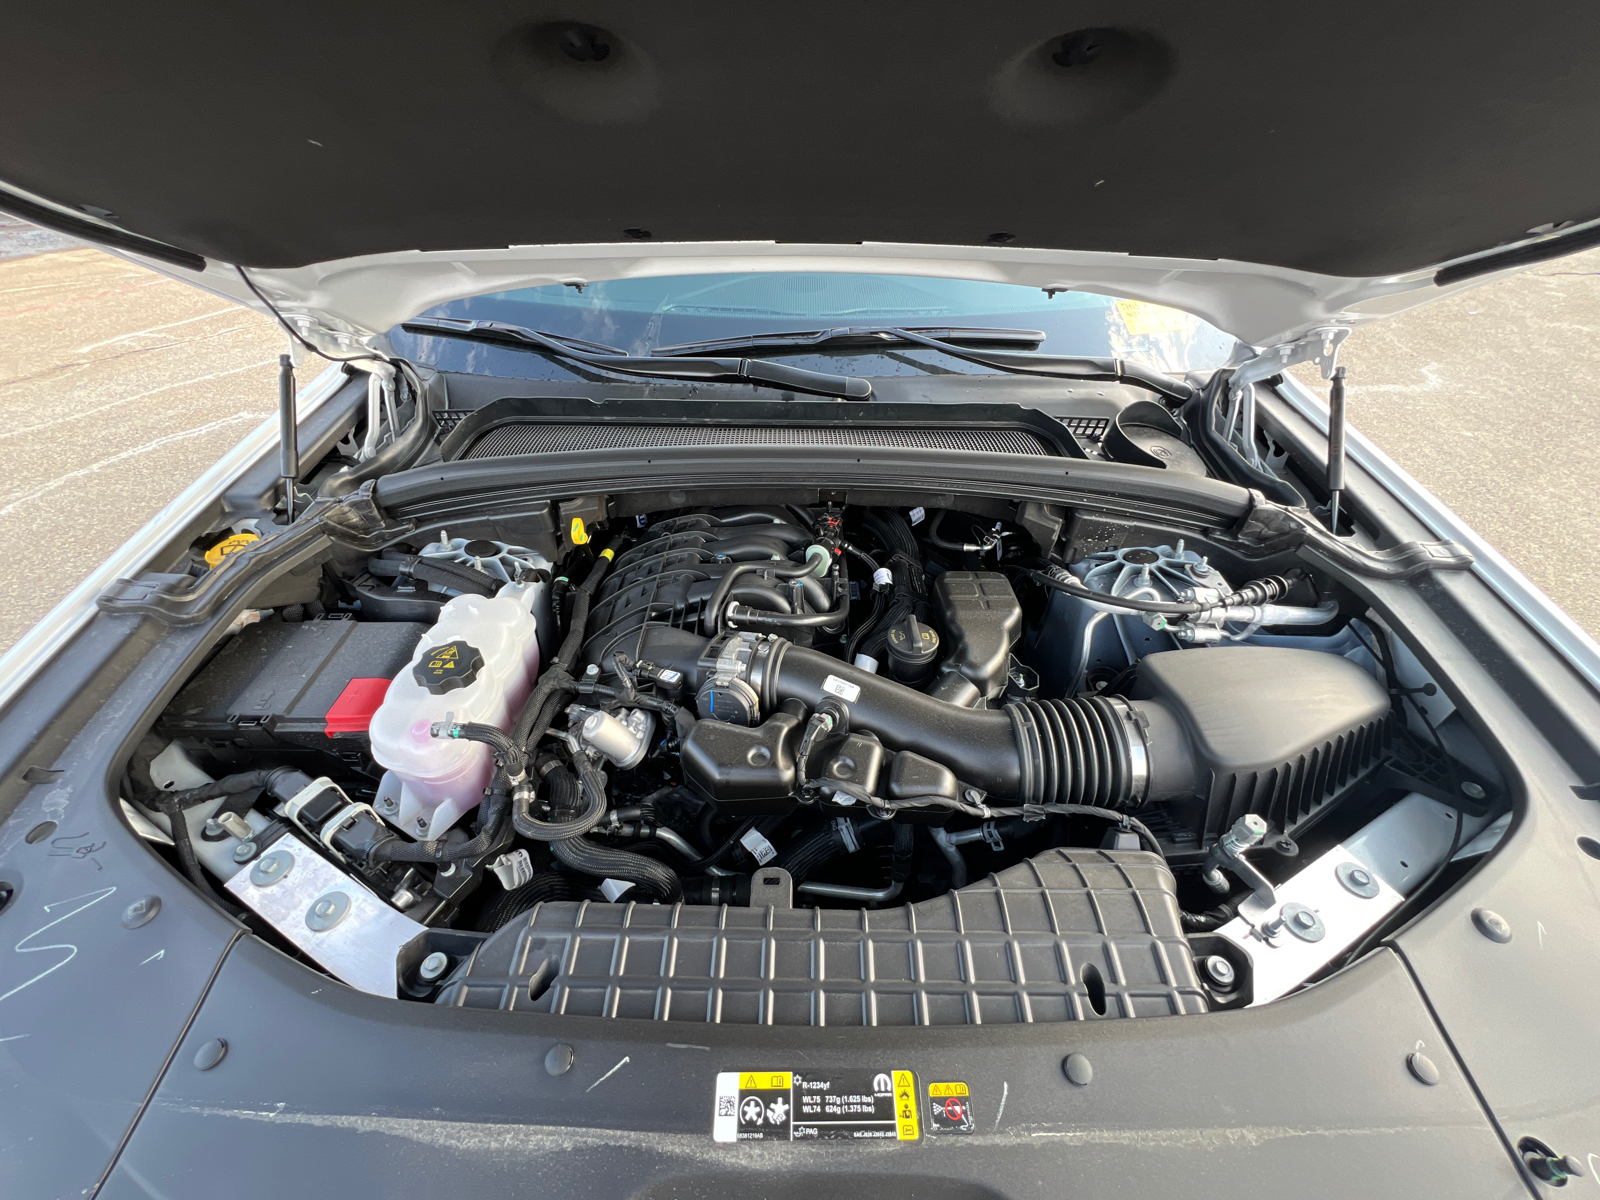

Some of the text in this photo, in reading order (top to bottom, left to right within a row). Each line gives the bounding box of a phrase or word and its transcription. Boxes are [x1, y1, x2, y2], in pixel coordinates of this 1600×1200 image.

[1120, 302, 1140, 310] THIS
[802, 1081, 830, 1091] R-1234yf
[802, 1095, 874, 1104] WL75 737g (1.625 lbs)
[802, 1105, 875, 1114] WL74 624g (1.375 lbs)
[805, 1127, 818, 1135] PAG
